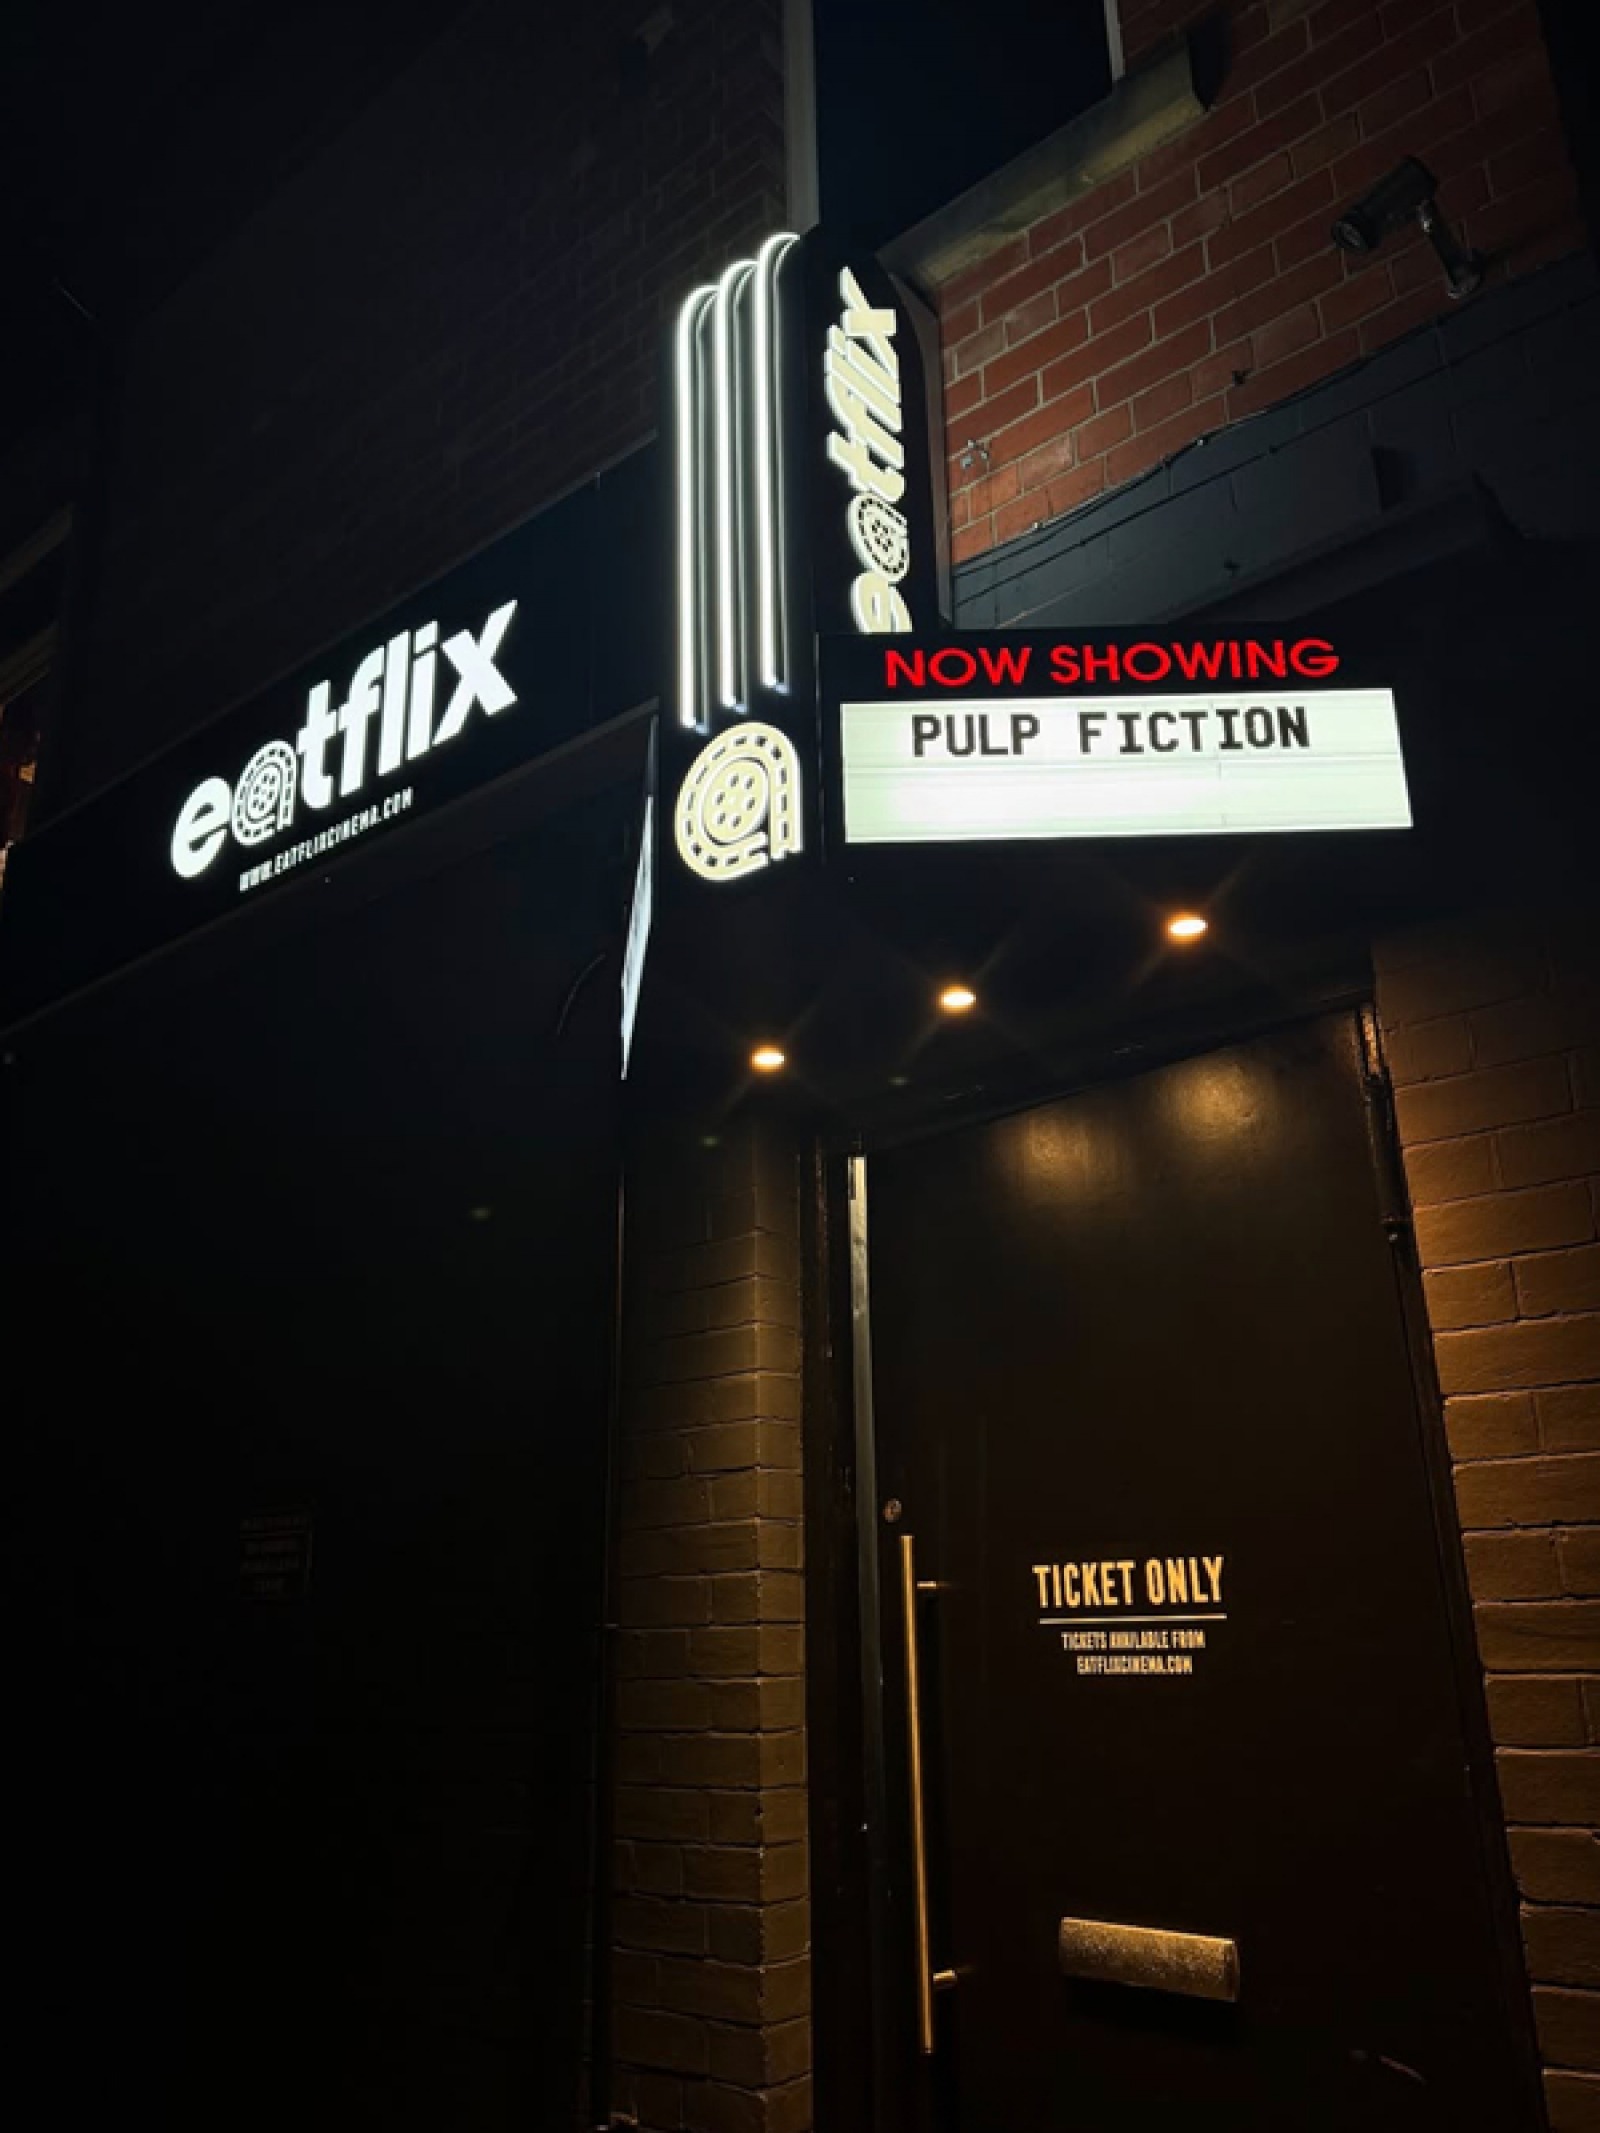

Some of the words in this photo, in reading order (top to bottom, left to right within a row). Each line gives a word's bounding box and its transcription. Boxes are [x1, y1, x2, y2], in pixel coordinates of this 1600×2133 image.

[885, 647, 1032, 688] NOW
[1050, 639, 1340, 683] SHOWING
[170, 598, 518, 879] eatflix
[911, 712, 1040, 757] PULP
[1079, 706, 1311, 754] FICTION
[1032, 1559, 1135, 1608] TICKET
[1145, 1554, 1224, 1605] ONLY
[1061, 1631, 1107, 1650] TICKETS
[1109, 1630, 1169, 1649] AVAILABLE
[1171, 1629, 1206, 1648] FROM
